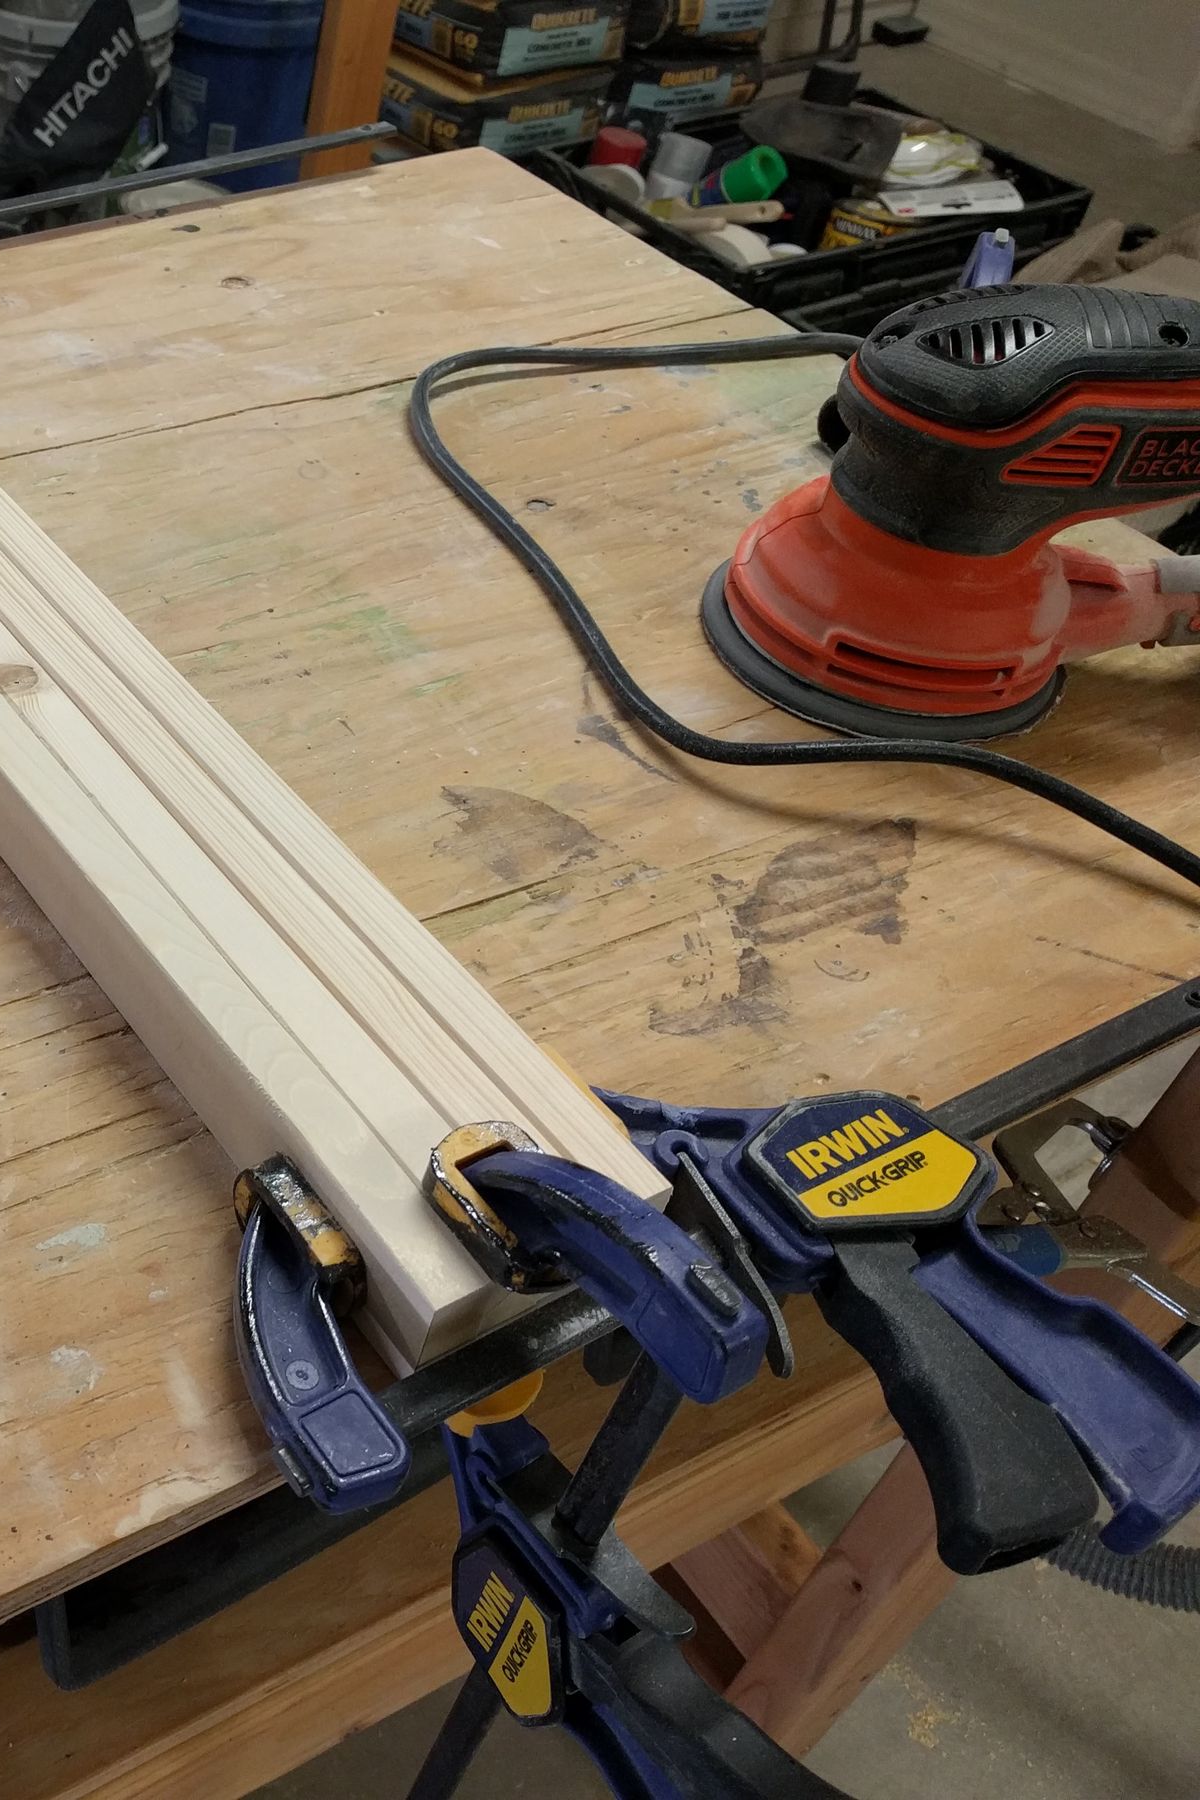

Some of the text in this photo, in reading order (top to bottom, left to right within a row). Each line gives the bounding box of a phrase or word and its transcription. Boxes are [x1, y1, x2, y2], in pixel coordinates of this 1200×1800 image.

[32, 26, 135, 148] HITACHI
[785, 1109, 906, 1180] IRWIN
[465, 1571, 515, 1653] IRWIN
